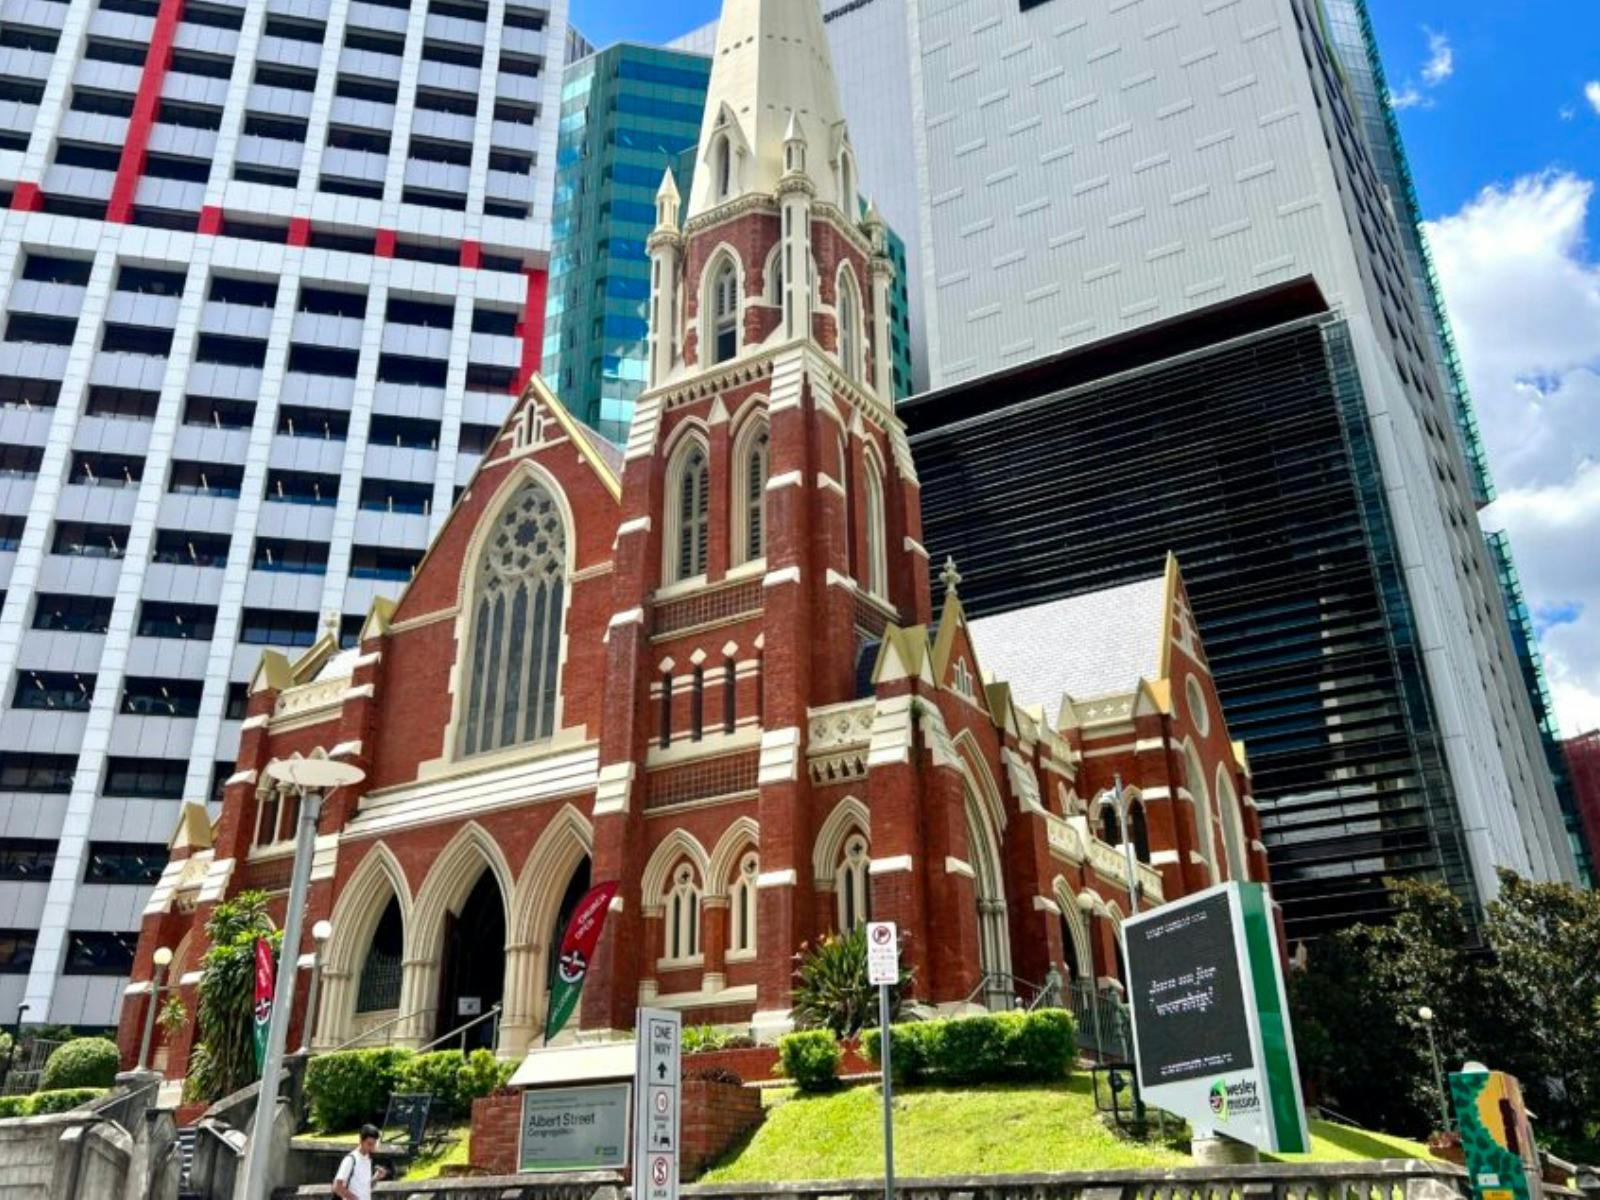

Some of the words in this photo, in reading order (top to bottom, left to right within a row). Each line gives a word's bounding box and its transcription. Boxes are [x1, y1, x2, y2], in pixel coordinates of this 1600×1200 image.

[654, 1025, 672, 1040] ONE
[654, 1041, 672, 1056] WAY
[1225, 1078, 1256, 1096] wesley
[528, 1114, 561, 1127] Albert
[562, 1111, 595, 1126] Street
